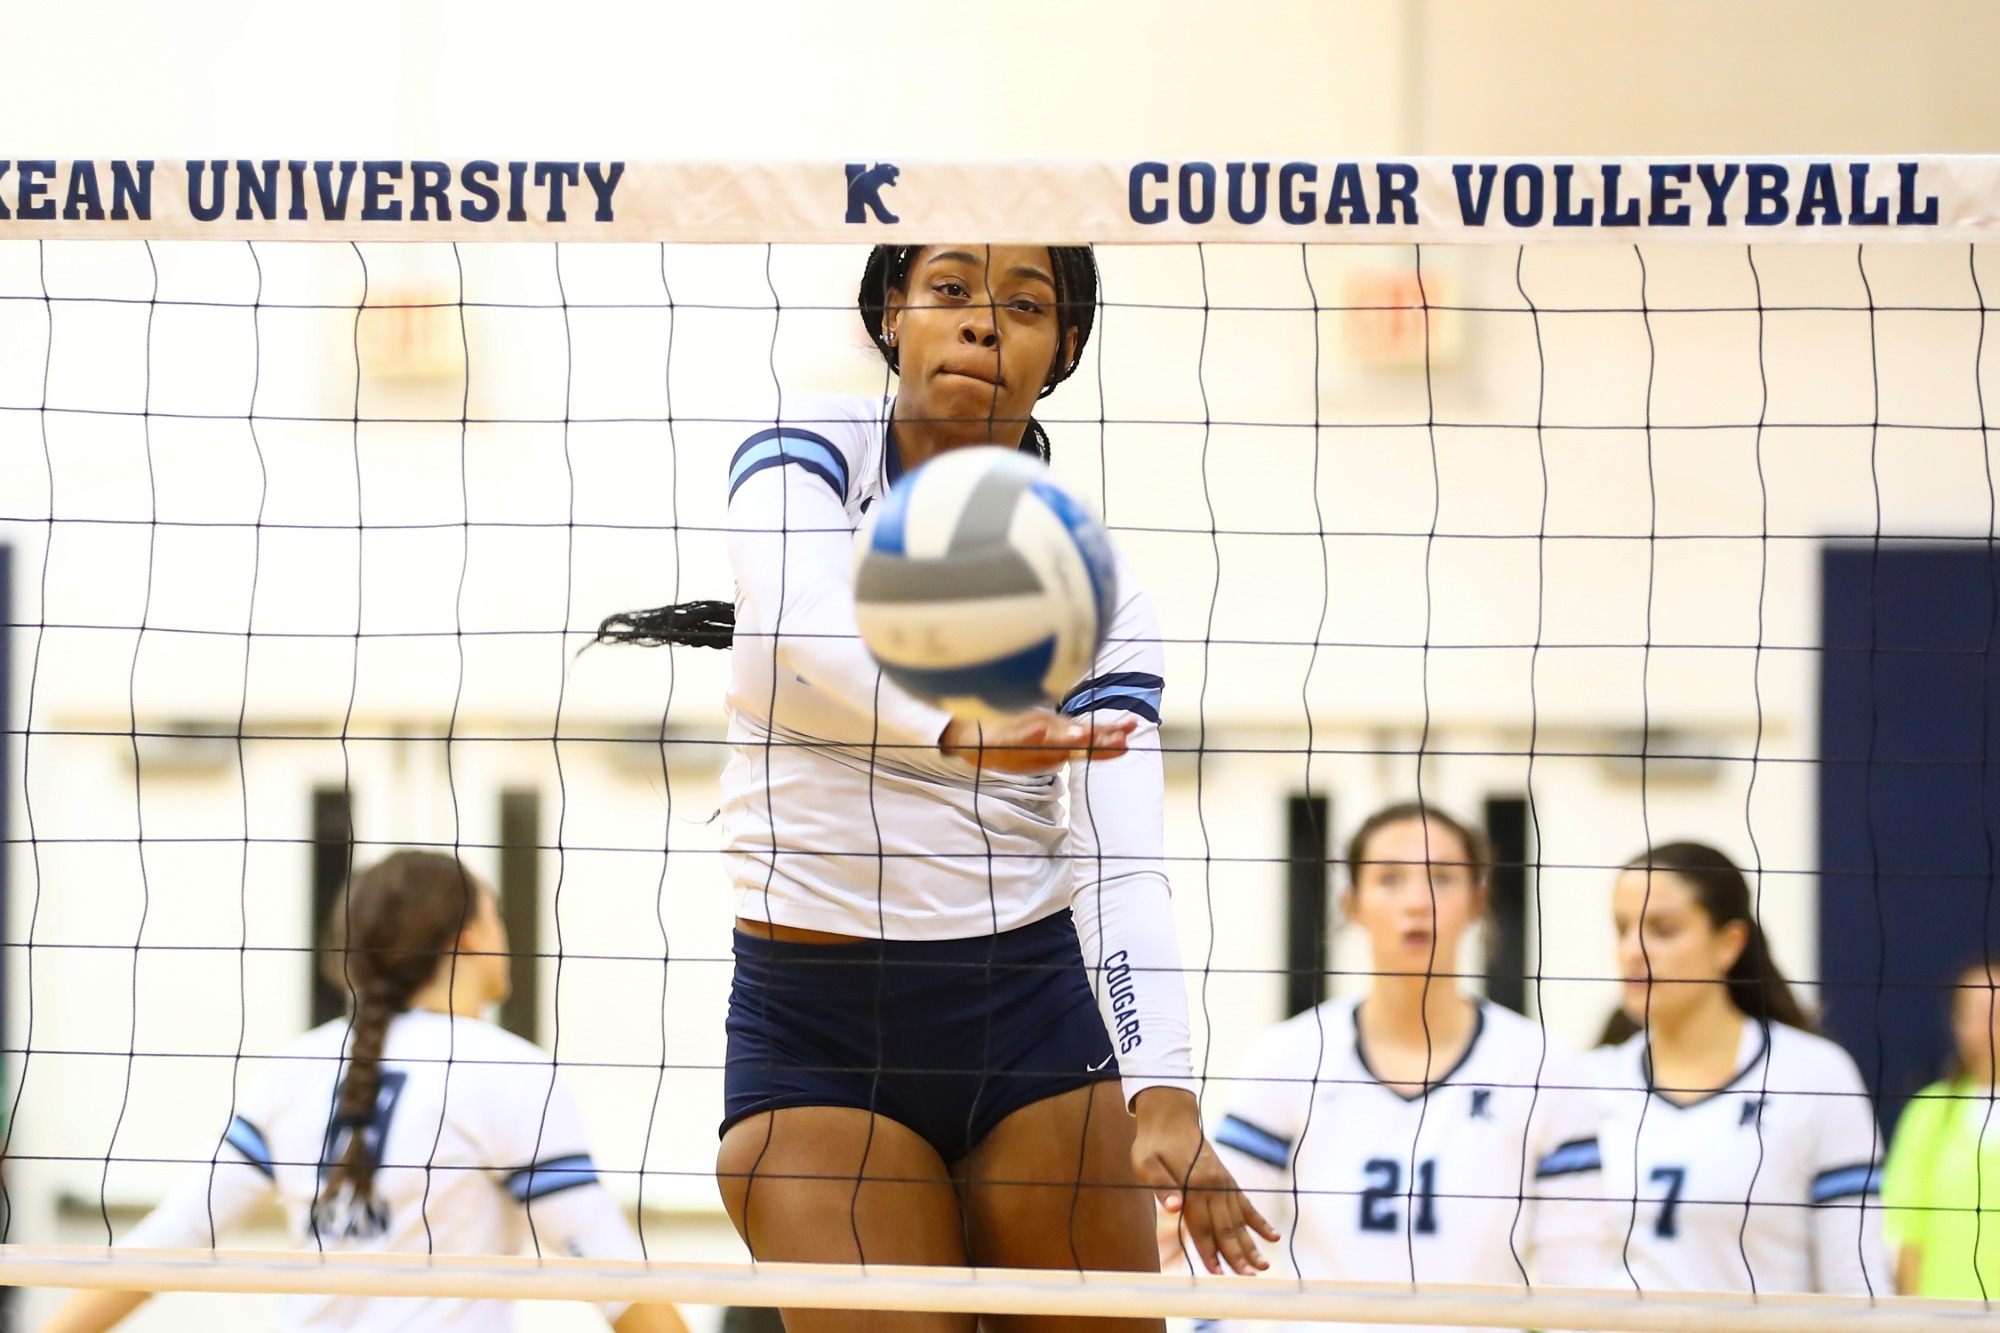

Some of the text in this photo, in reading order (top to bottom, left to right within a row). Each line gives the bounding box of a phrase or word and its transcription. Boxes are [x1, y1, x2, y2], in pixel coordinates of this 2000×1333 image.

[0, 160, 625, 222] EAN UNIVERSITY
[1128, 162, 1939, 228] COUGAR VOLLEYBALL
[1104, 950, 1142, 1055] COUGARS
[1360, 1158, 1436, 1233] 21
[1650, 1166, 1687, 1238] 7
